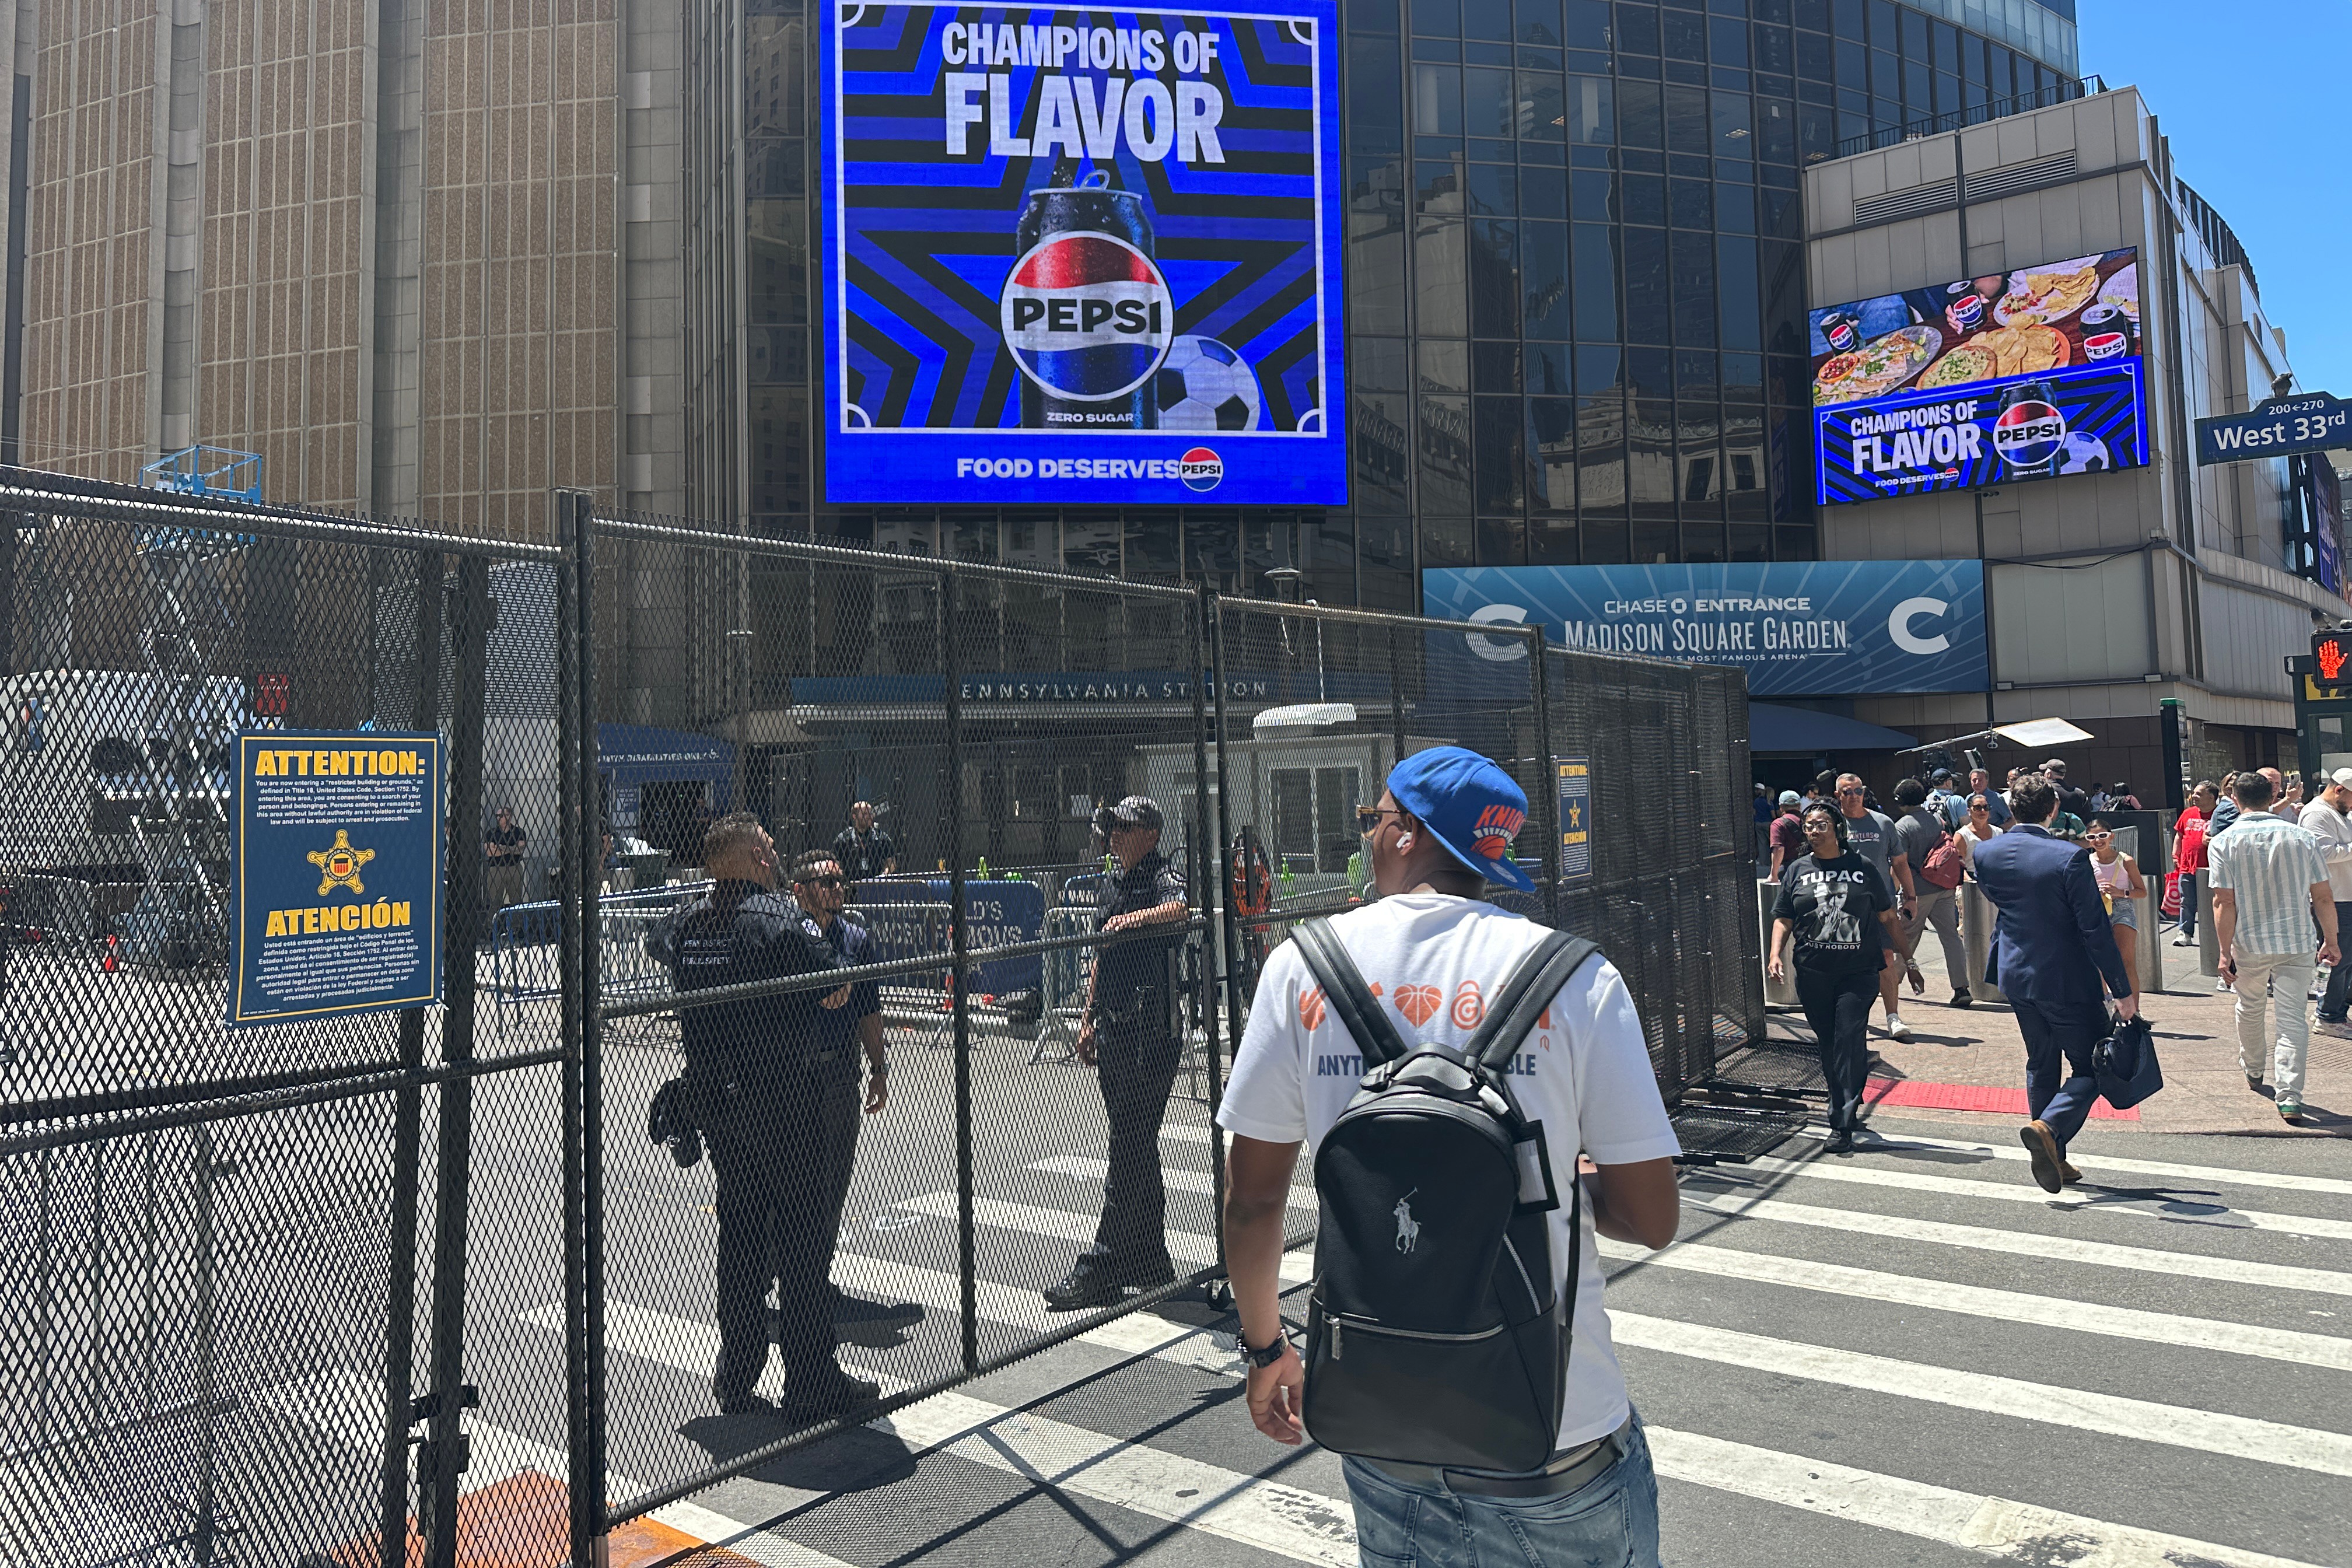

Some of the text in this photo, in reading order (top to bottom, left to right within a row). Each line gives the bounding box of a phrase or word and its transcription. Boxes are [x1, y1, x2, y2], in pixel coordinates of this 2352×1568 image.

[942, 22, 1220, 74] CHAMPIONS OF
[945, 72, 1225, 163] FLAVOR
[1013, 298, 1161, 334] PEPSI
[1956, 302, 1980, 316] PEPSI
[1832, 329, 1852, 344] PEPSI
[2087, 340, 2124, 355] PEPSI
[1046, 412, 1134, 422] ZERO SUGAR
[2269, 399, 2324, 415] 200 270
[1850, 400, 1978, 437] CHAMPIONS OF
[1997, 422, 2061, 443] PEPSI
[2213, 410, 2346, 450] West 33rd
[1852, 422, 1982, 475] FLAVOR
[957, 458, 1220, 479] FOOD DESERVES PEPSI
[1875, 478, 1899, 488] FOOD
[1899, 473, 1945, 485] DESERVES
[1605, 597, 1810, 614] CHASE ENTRANCE
[1565, 617, 1847, 653] MADISON SQUARE GARDEN
[1888, 597, 1950, 654] C
[961, 682, 1148, 699] ENNSYLVANIA
[255, 750, 425, 776] ATTENTION:
[1800, 870, 1864, 886] TUPAC
[265, 896, 410, 937] ATENCIÓN
